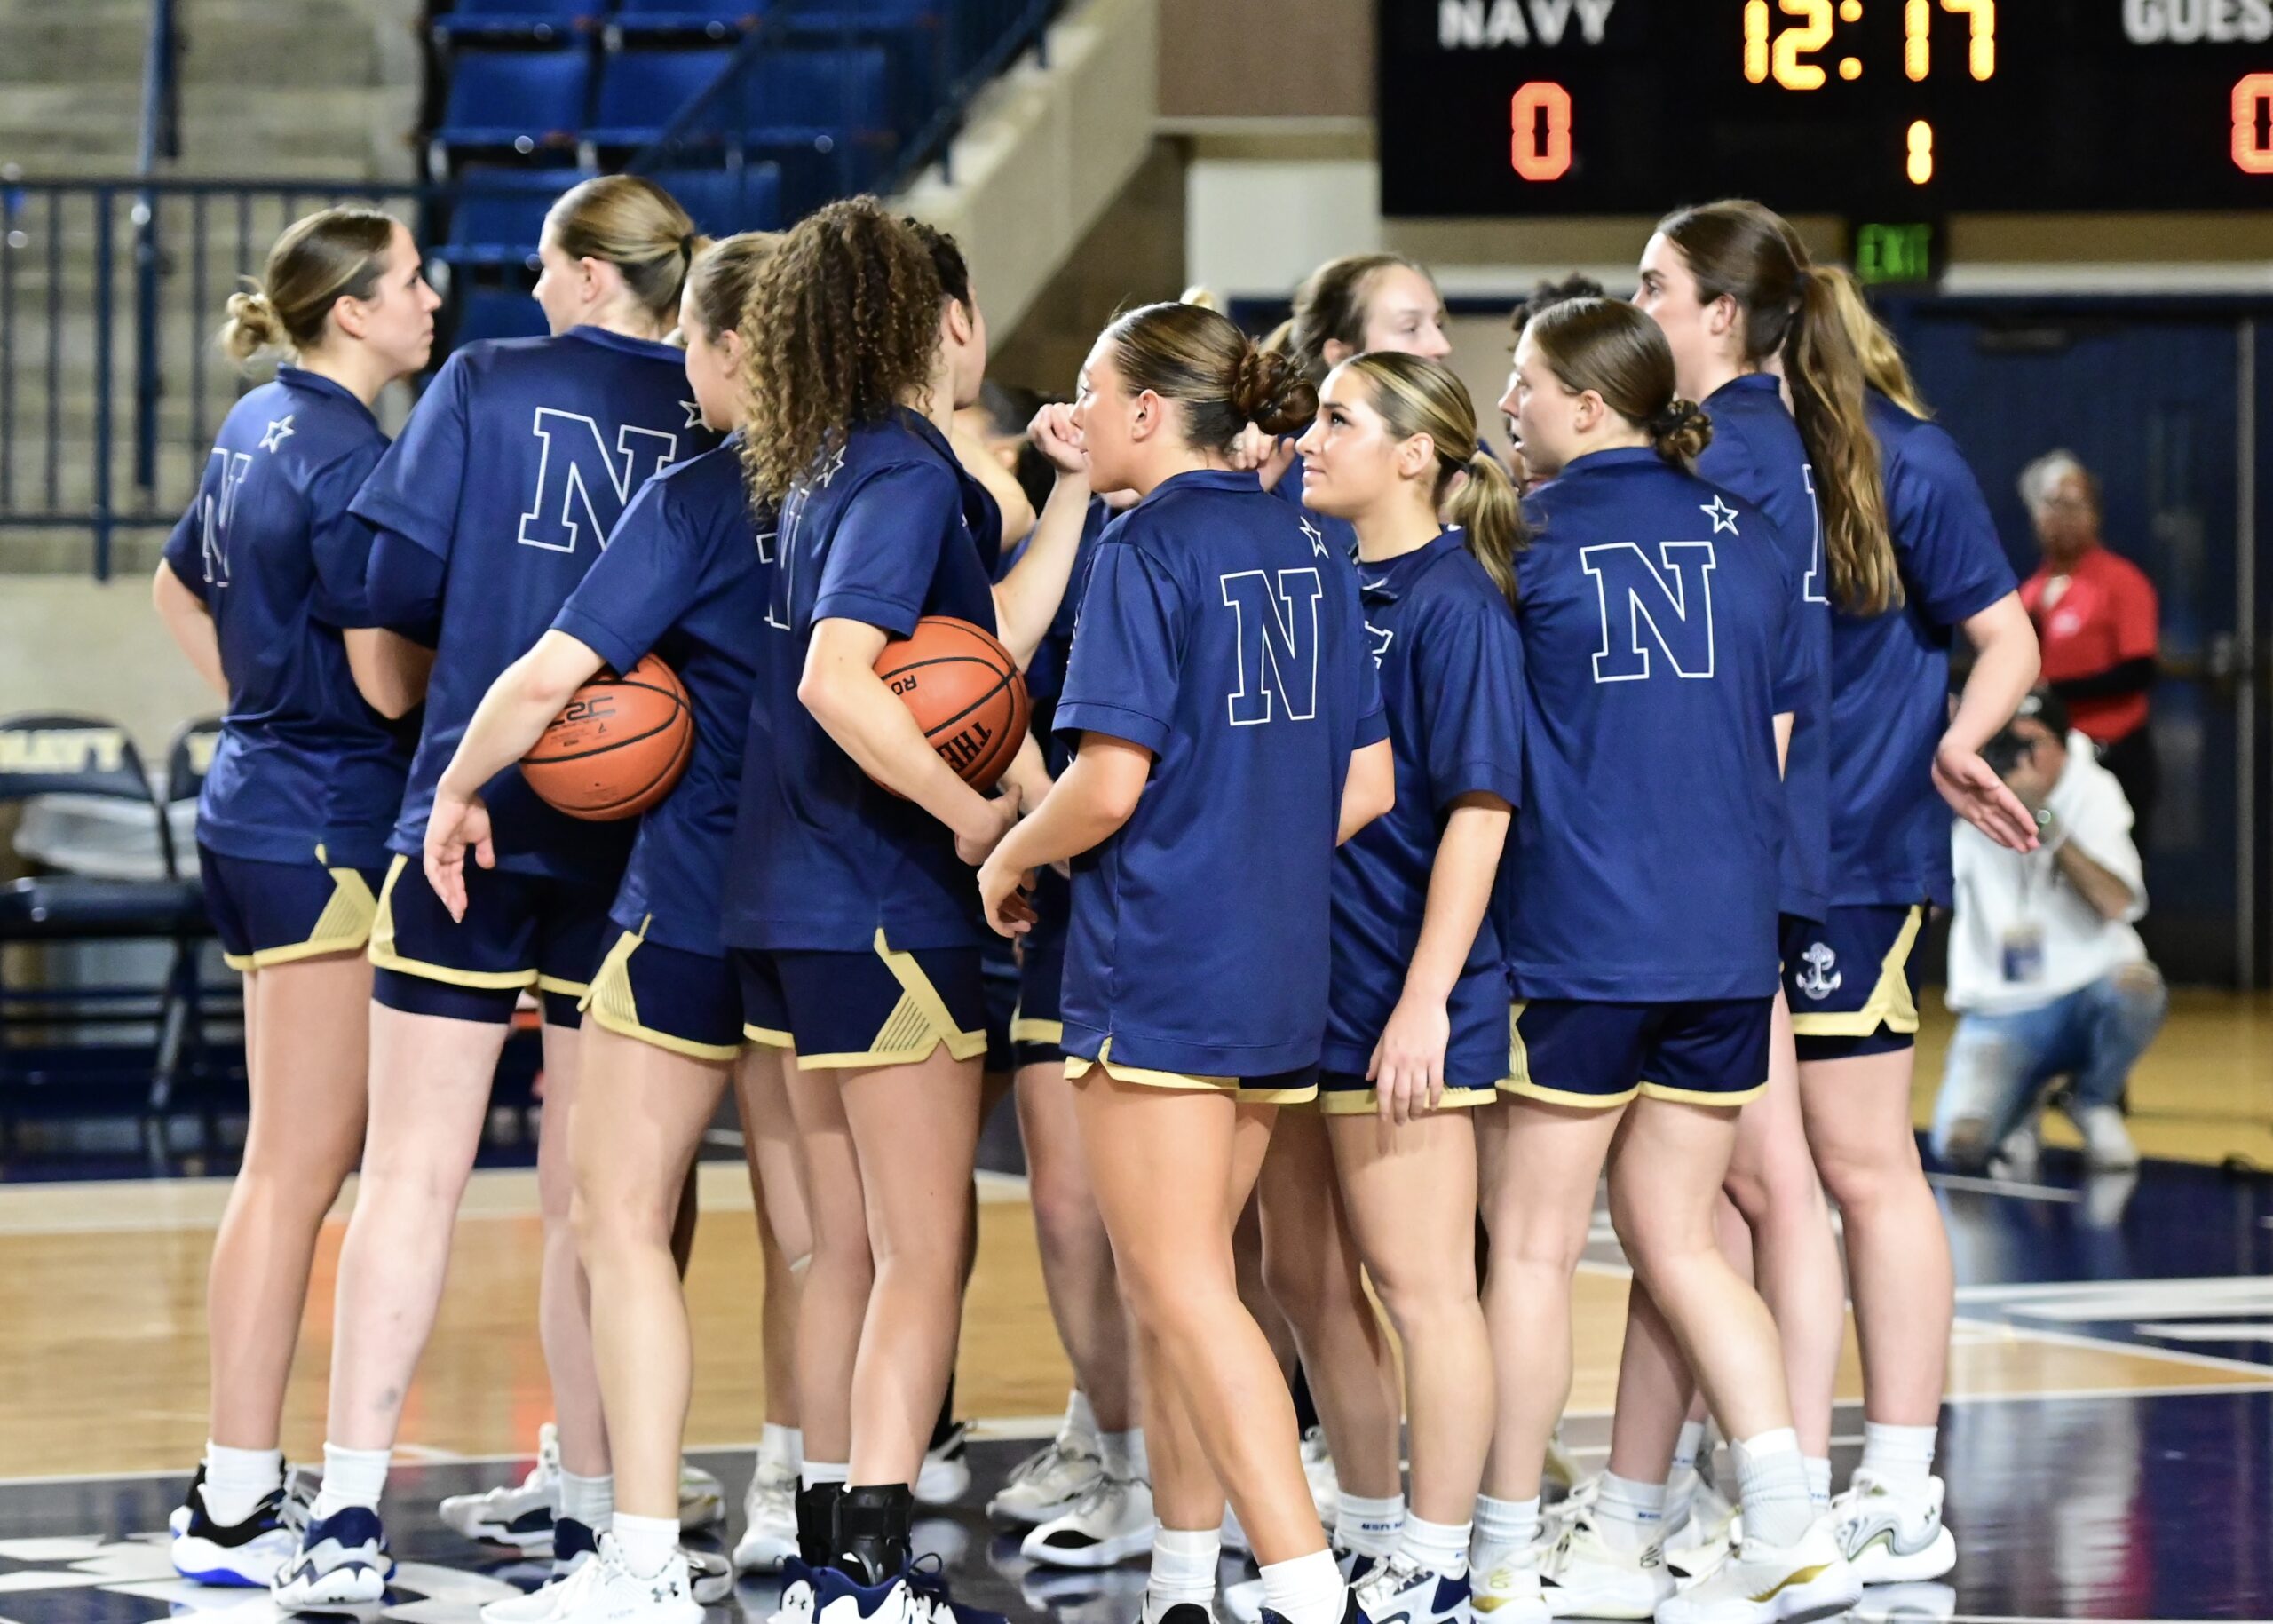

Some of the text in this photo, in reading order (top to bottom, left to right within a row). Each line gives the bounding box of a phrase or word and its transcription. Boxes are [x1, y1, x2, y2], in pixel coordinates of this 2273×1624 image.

[1437, 0, 1614, 47] NAVY
[1745, 0, 1994, 90] 12:17
[1511, 82, 1571, 181] 0
[1907, 120, 1932, 184] 1
[518, 407, 677, 553] N
[1220, 567, 1323, 725] N
[1580, 541, 1716, 683] N
